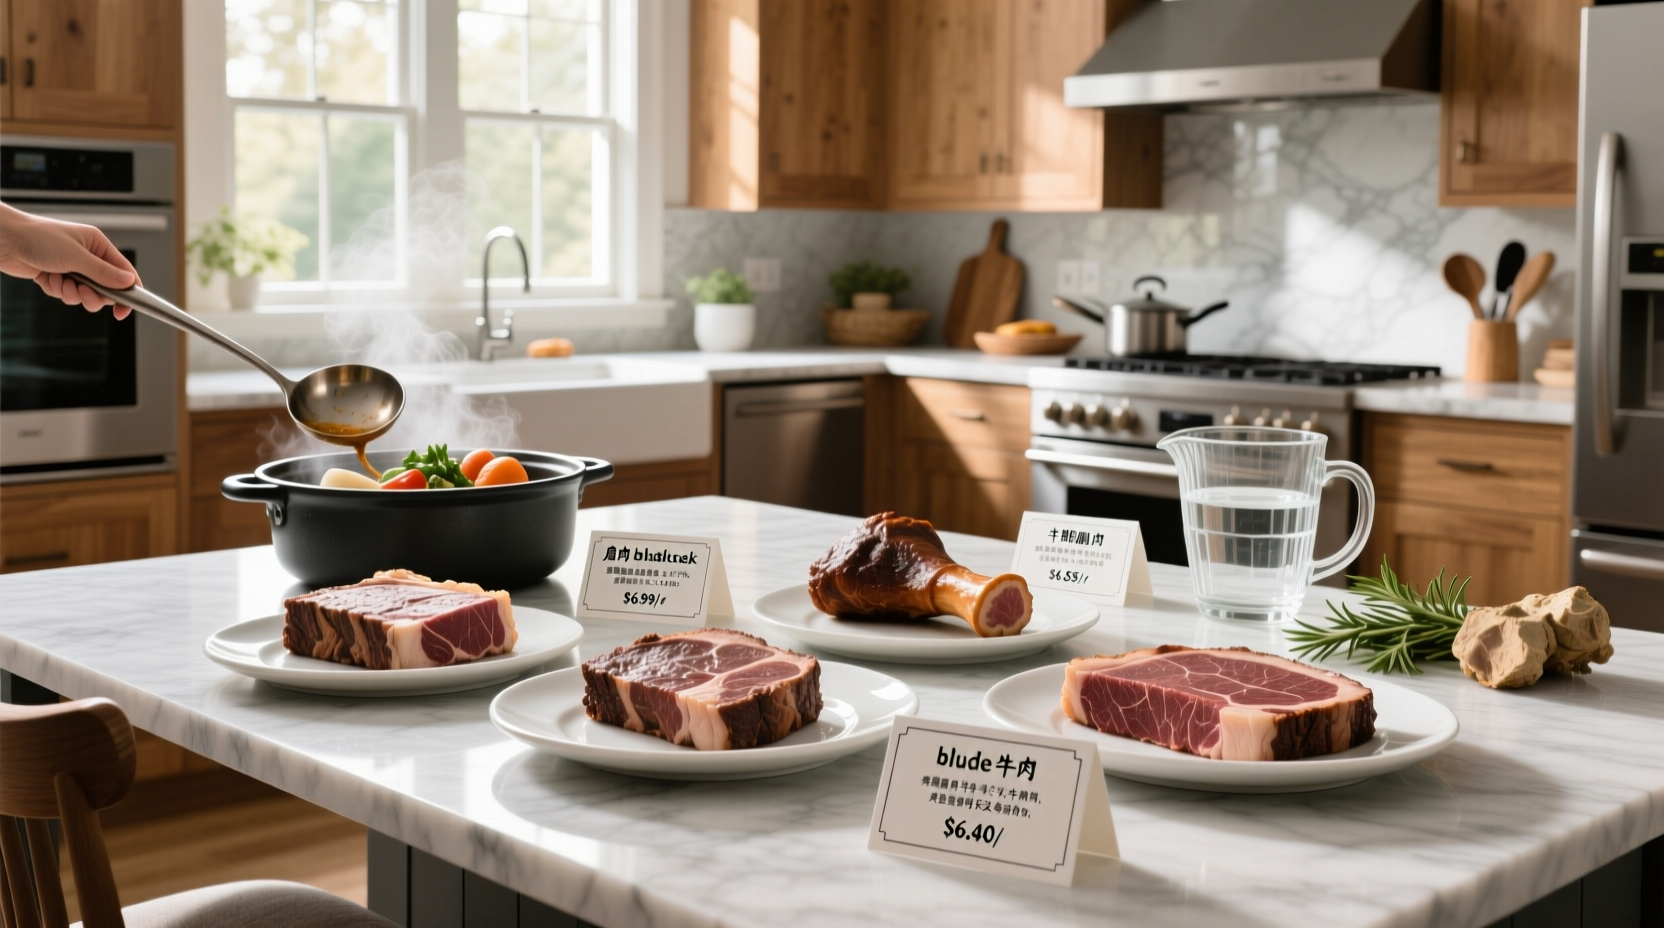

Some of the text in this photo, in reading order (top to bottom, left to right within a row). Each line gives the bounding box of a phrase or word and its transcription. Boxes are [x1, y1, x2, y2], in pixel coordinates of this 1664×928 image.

[937, 746, 1037, 781] blude 牛肉
[943, 816, 1004, 848] $6.40/
